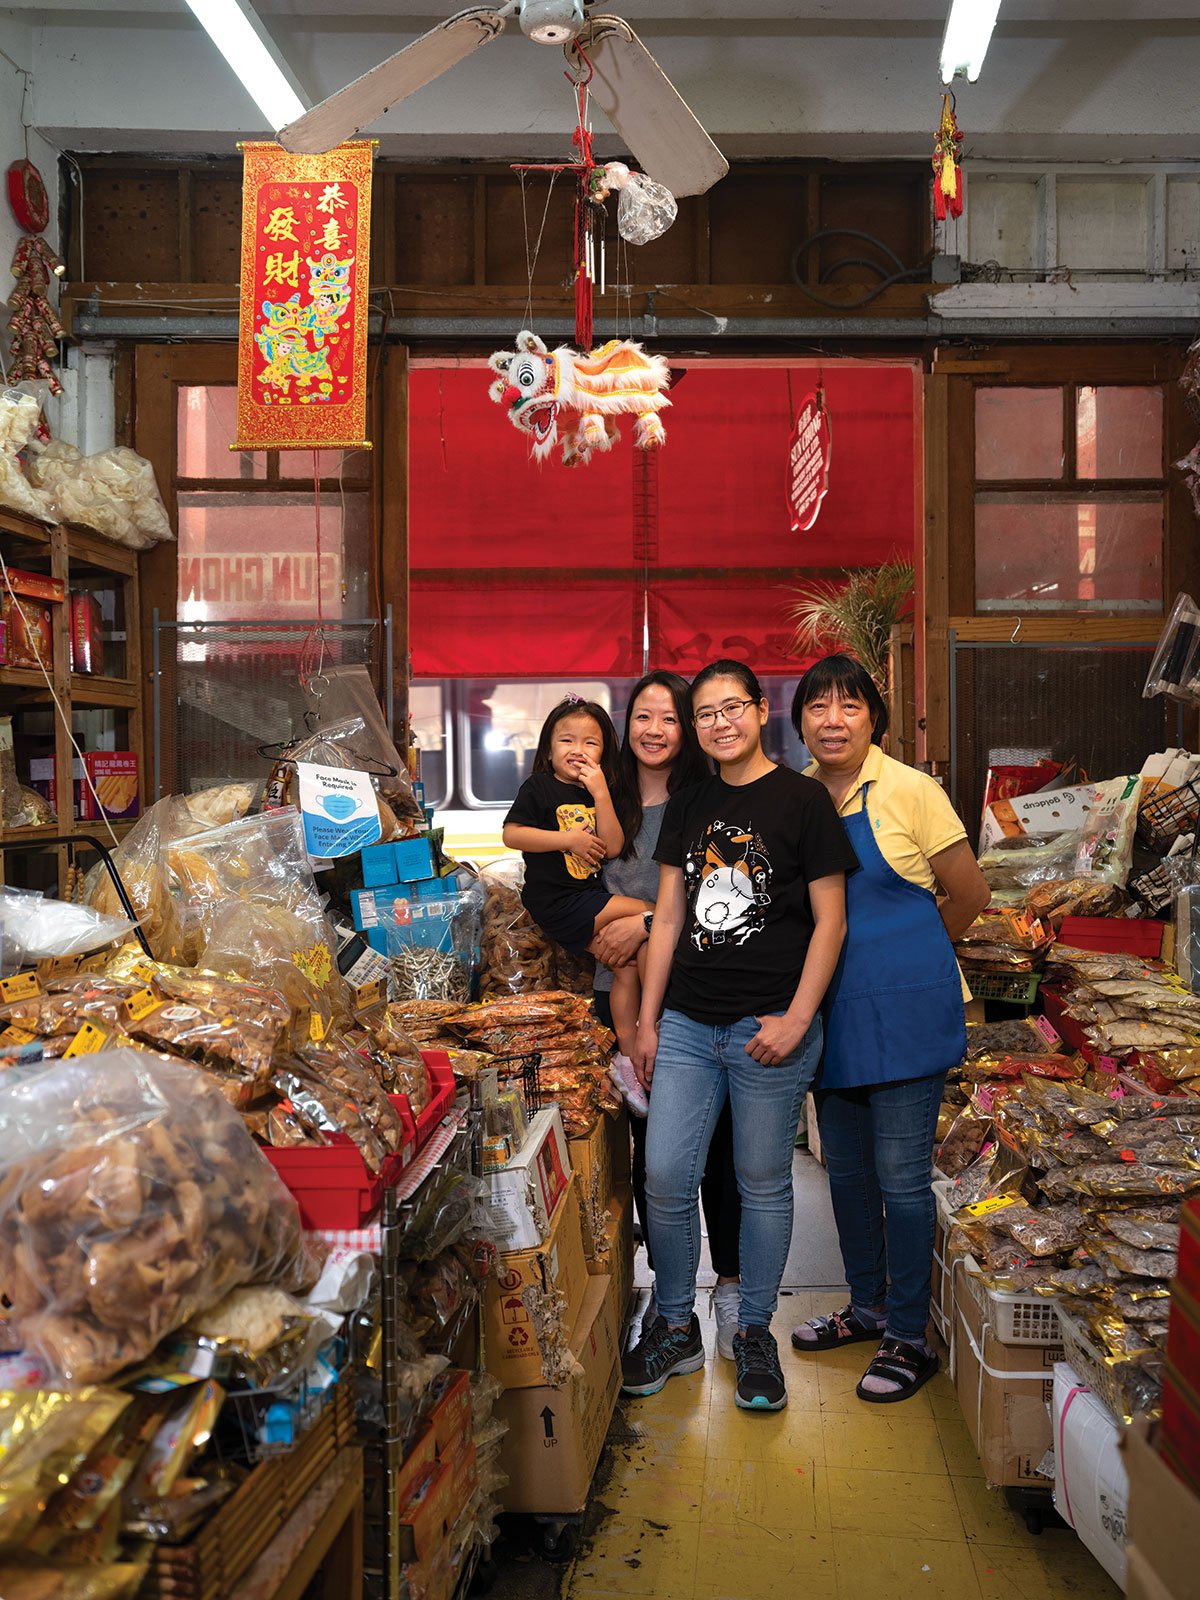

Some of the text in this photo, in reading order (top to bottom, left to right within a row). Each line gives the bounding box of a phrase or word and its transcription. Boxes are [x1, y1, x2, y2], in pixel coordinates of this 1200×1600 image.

[314, 182, 349, 251] 恭喜
[263, 206, 303, 288] 發財
[315, 774, 332, 782] Face
[332, 777, 350, 785] Mask
[322, 781, 354, 791] Required
[1023, 796, 1061, 809] goldcup
[312, 826, 333, 834] Please
[543, 1438, 559, 1449] UP
